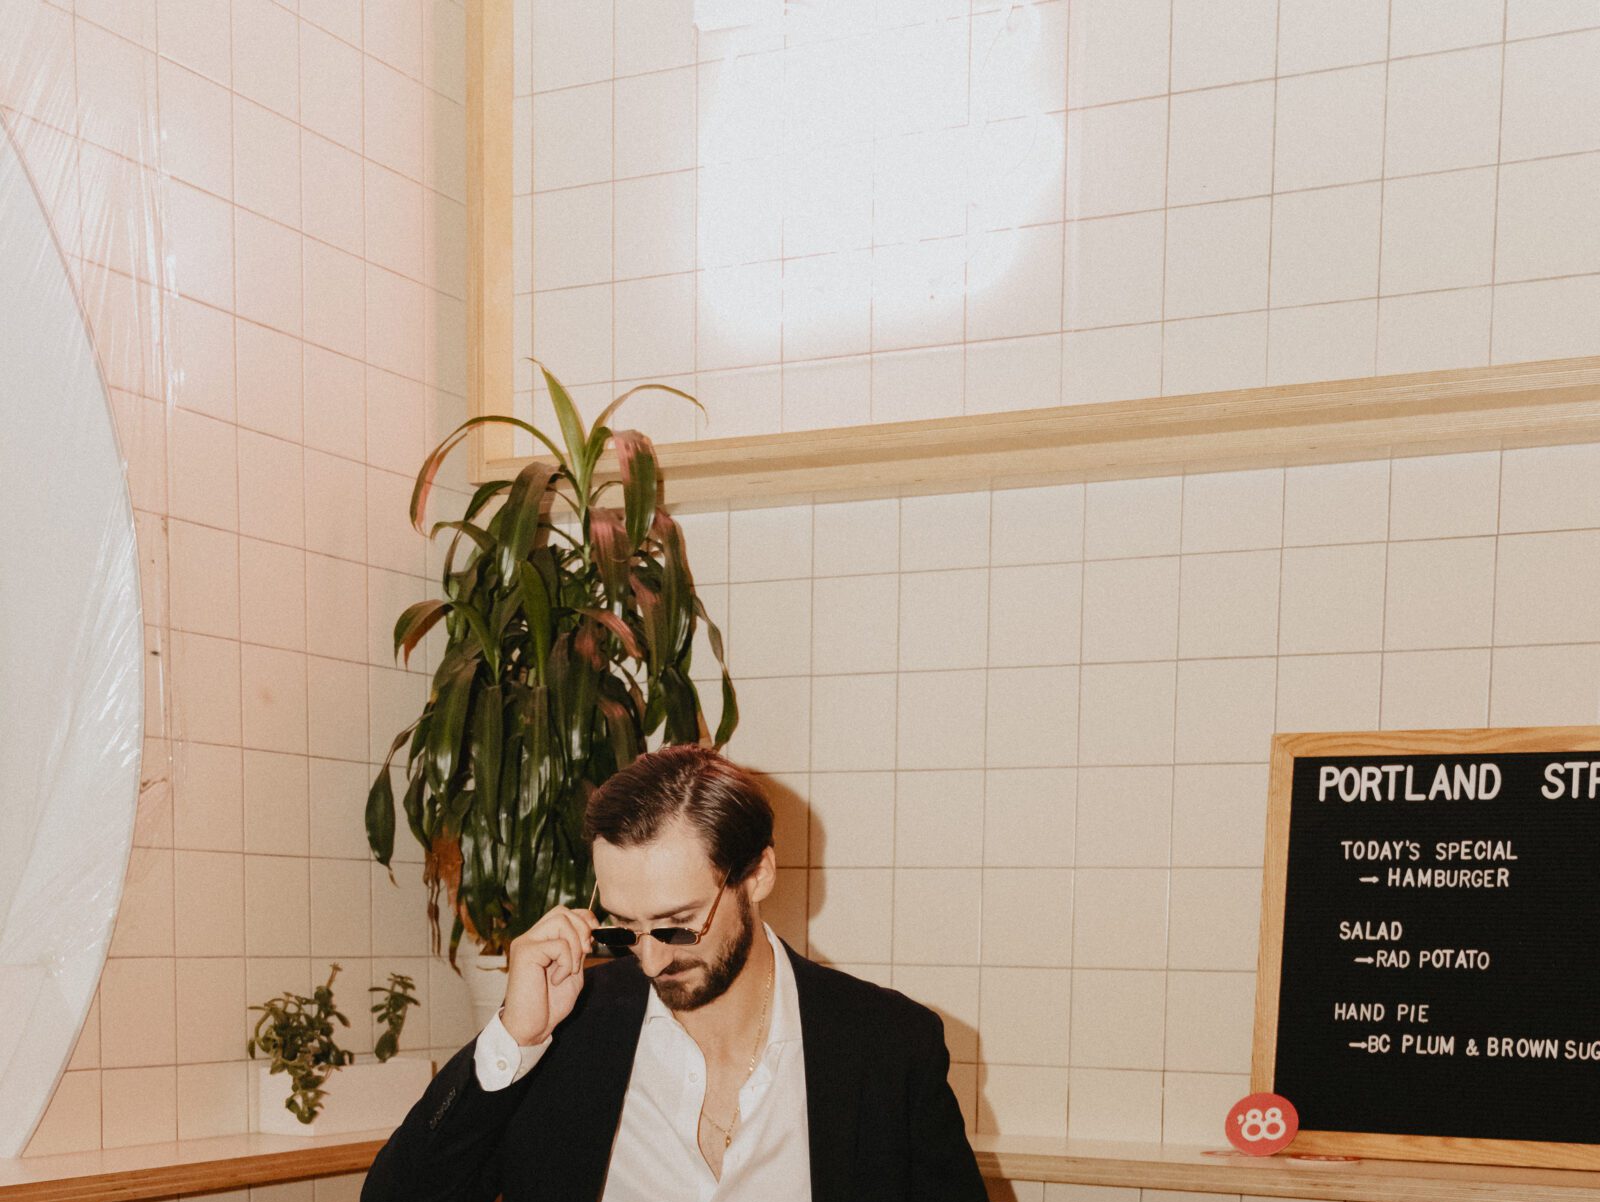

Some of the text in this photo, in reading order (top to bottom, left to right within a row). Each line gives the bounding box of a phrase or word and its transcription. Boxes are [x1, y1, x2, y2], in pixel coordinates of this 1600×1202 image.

[1319, 763, 1501, 802] PORTLAND
[1341, 840, 1518, 861] TODAY'S SPECIAL
[1388, 868, 1509, 888] HAMBURGER
[1340, 921, 1402, 940] SALAD
[1376, 949, 1490, 970] RAD POTATO
[1335, 1003, 1429, 1023] HAND PIE
[1367, 1034, 1390, 1053] BC
[1402, 1034, 1454, 1055] PLUM
[1466, 1039, 1479, 1056] &
[1487, 1037, 1558, 1059] BROWN
